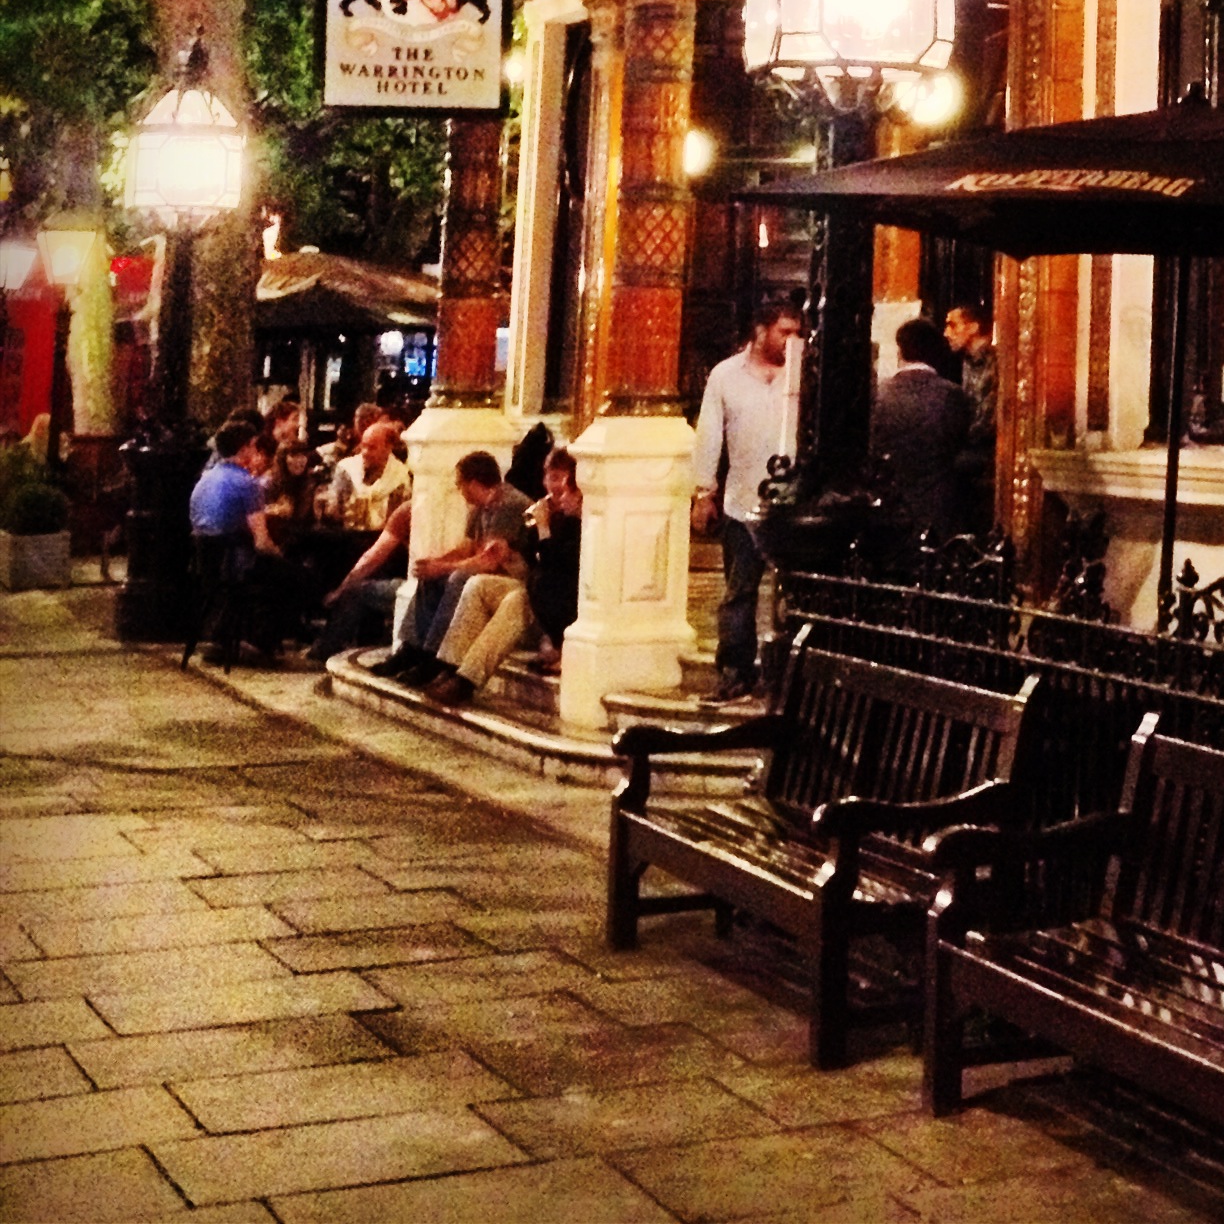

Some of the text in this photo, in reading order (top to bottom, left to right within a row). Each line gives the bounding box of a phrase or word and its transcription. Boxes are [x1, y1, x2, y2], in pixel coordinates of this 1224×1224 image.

[392, 46, 434, 62] THE
[339, 62, 486, 81] WARRINGTON
[377, 80, 448, 95] HOTEL
